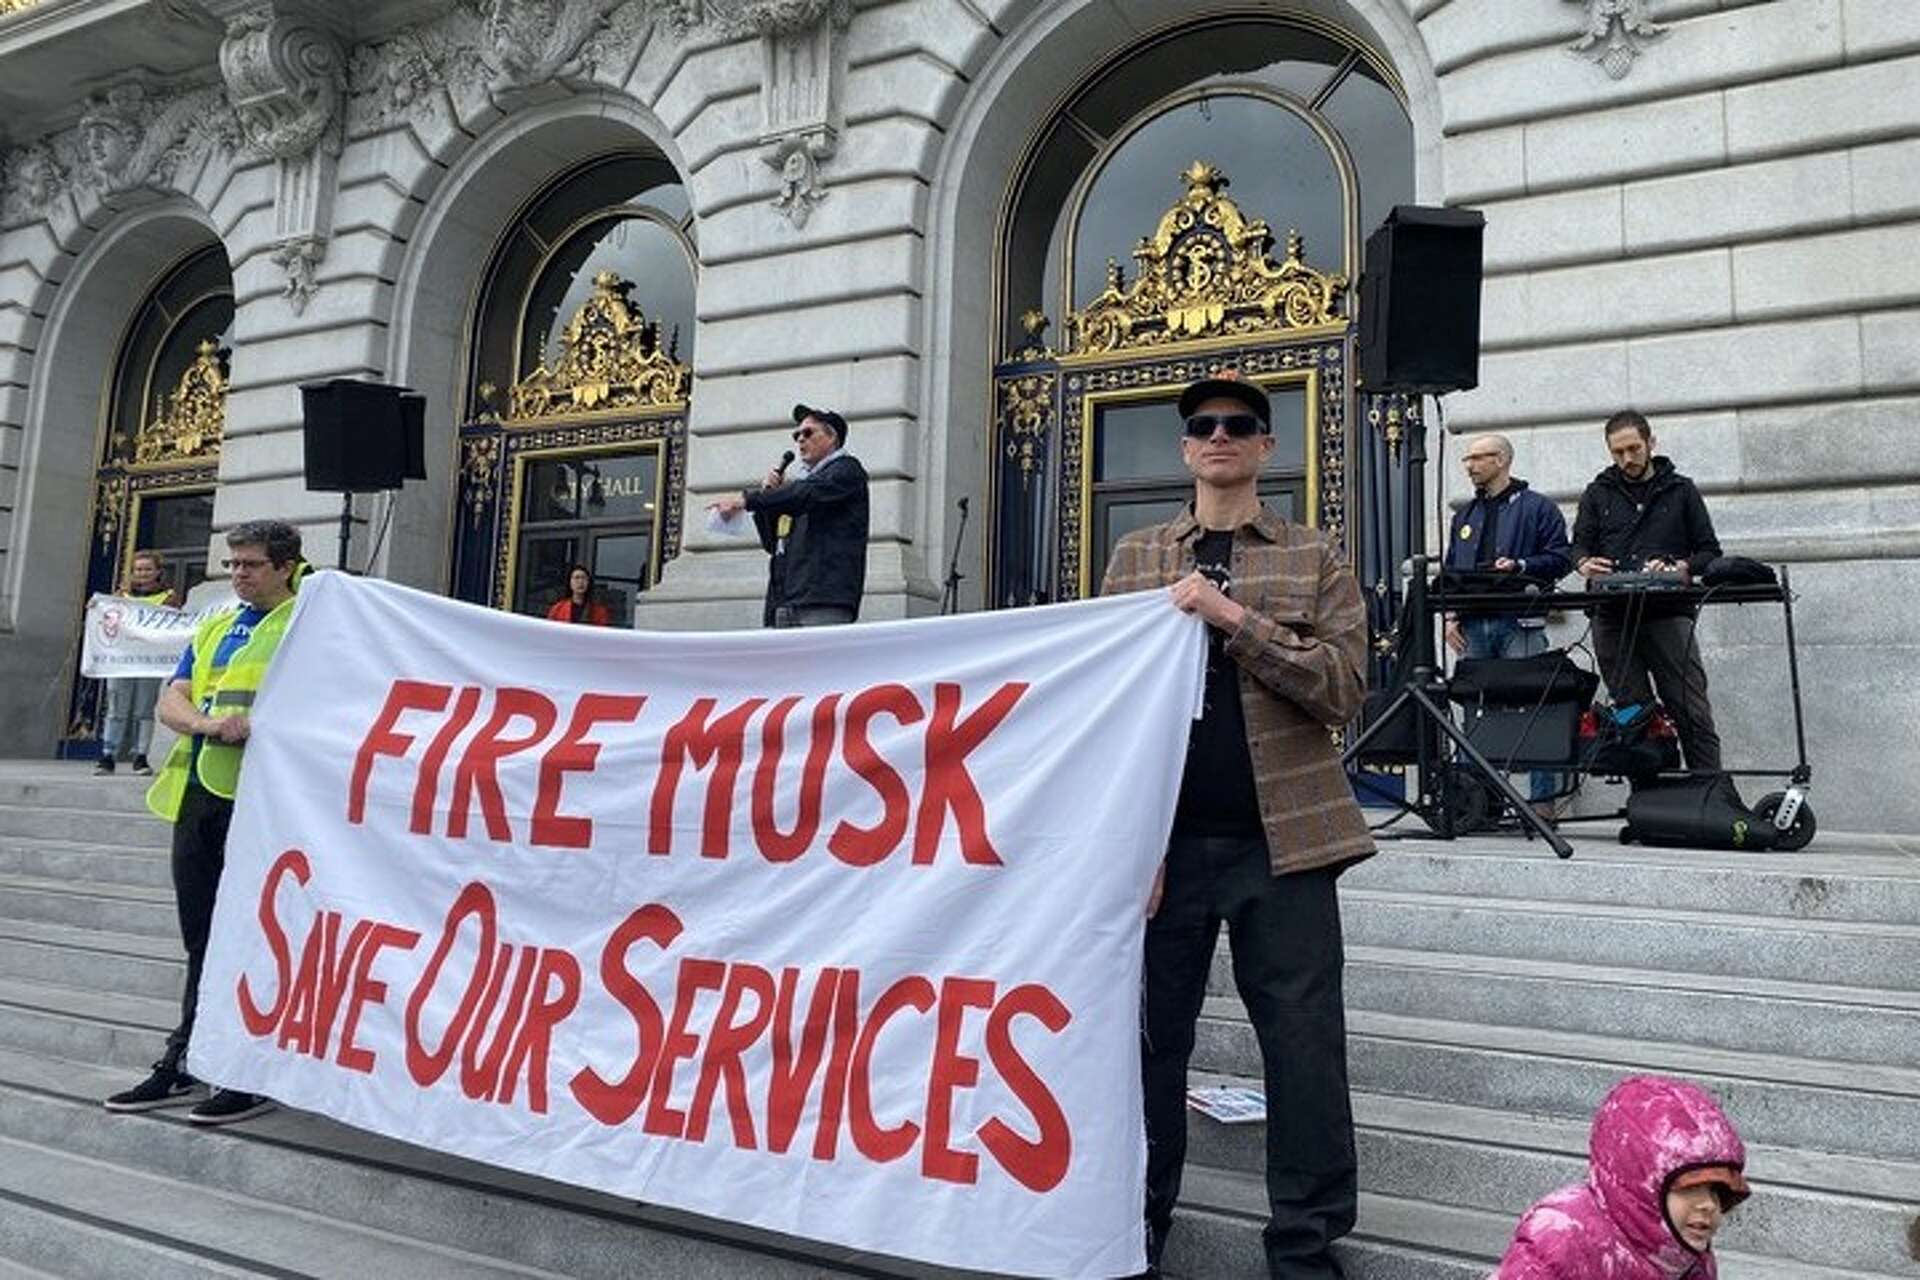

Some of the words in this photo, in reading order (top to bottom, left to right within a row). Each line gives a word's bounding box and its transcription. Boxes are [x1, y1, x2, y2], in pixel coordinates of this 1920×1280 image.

[349, 681, 647, 849] FIRE
[648, 682, 1029, 867] MUSK
[237, 850, 420, 1074] SAVE
[405, 881, 582, 1114] OUR
[570, 904, 1072, 1194] SERVICES
